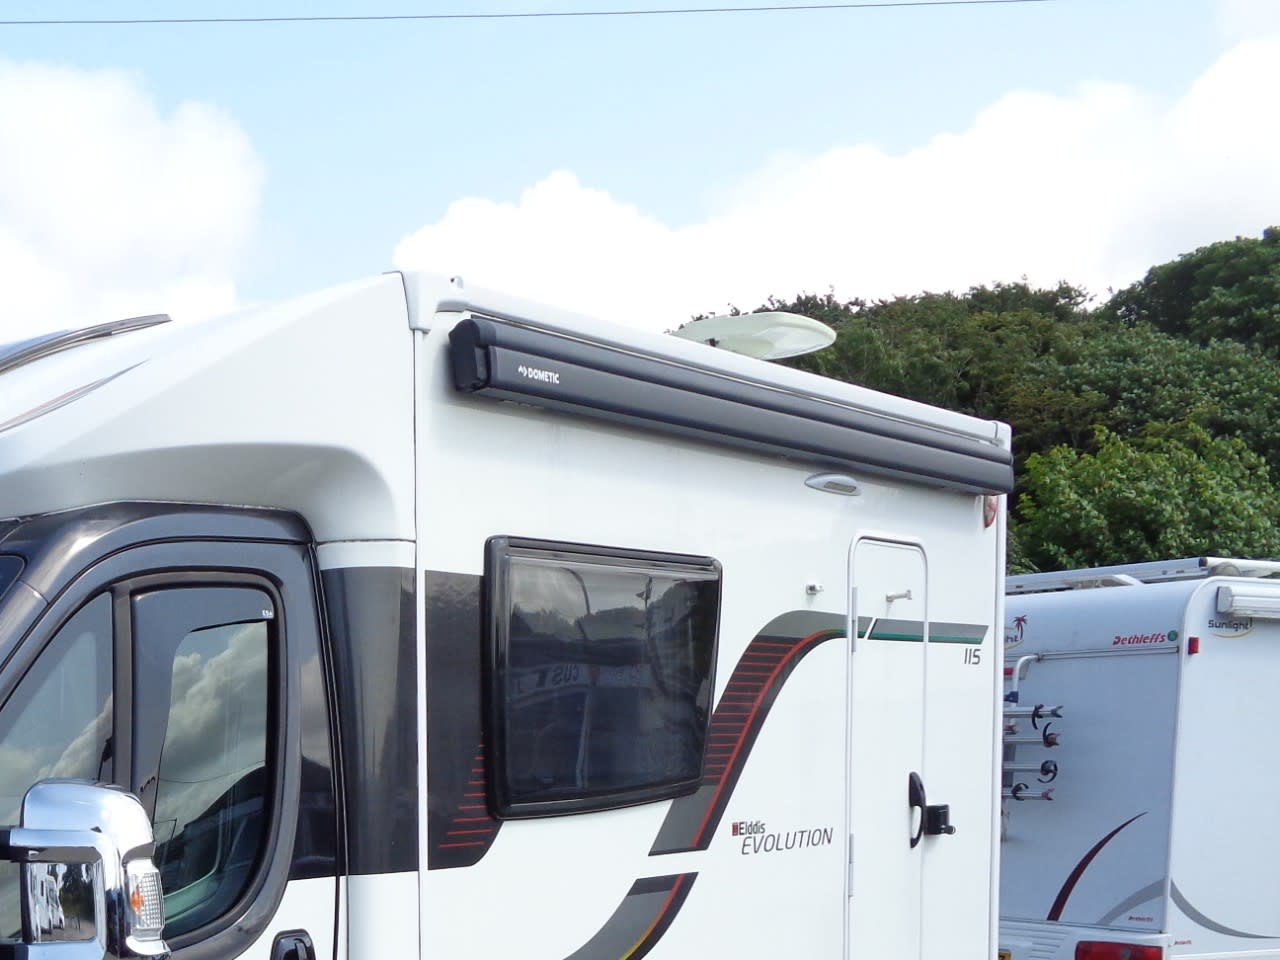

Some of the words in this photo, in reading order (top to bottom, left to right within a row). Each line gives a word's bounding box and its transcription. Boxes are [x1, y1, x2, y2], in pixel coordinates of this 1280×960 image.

[527, 367, 560, 384] DOMETIC
[1207, 619, 1249, 632] Sunlight
[1112, 632, 1167, 647] Dethleffs
[738, 820, 766, 836] Elddis
[741, 827, 833, 855] EVOLUTION
